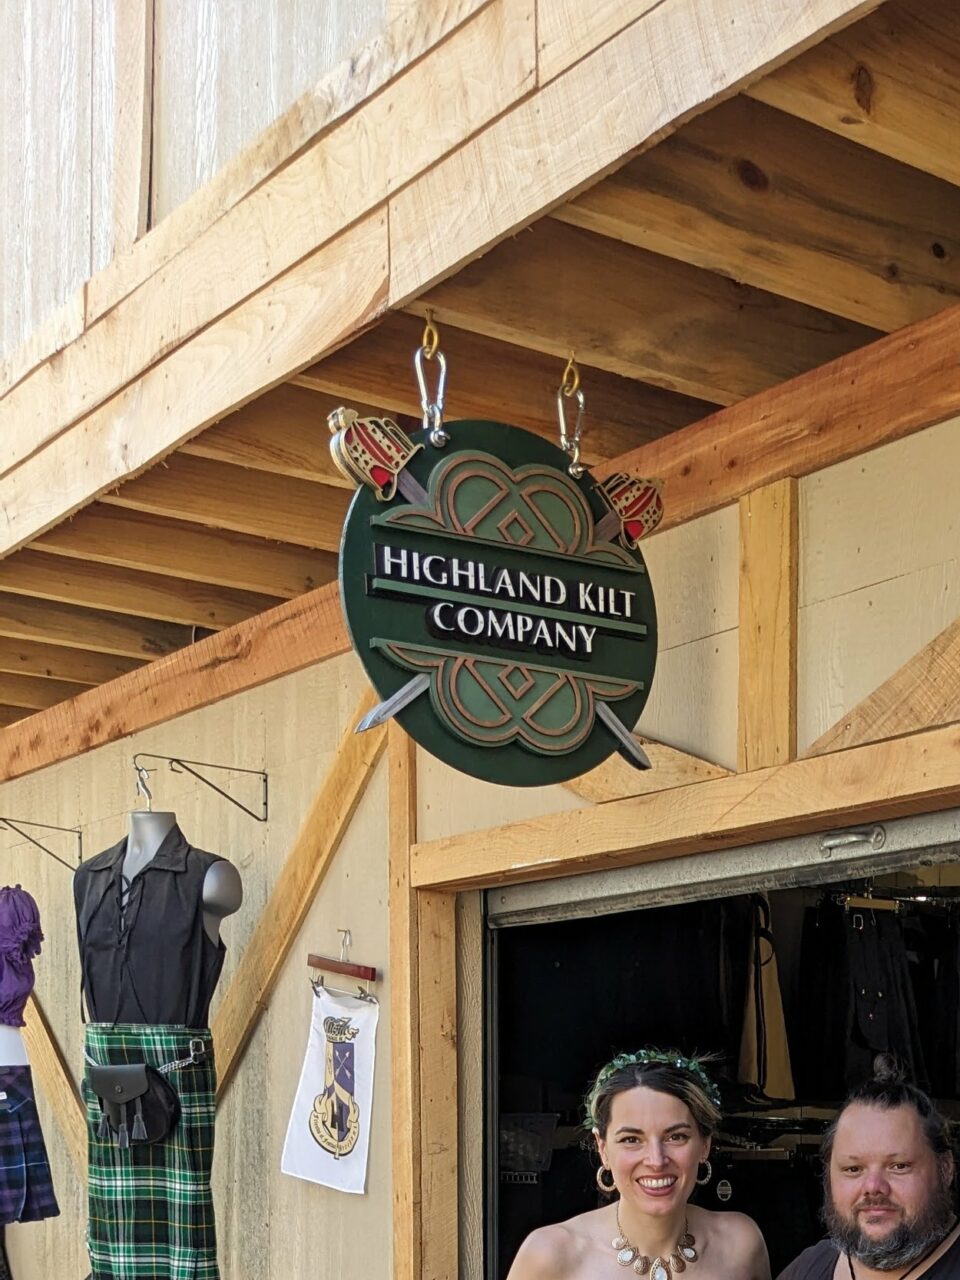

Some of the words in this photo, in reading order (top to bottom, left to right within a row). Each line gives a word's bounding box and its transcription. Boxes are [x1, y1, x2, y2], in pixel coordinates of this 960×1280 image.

[383, 546, 567, 606] HIGHLAND
[579, 582, 636, 618] KILT
[433, 602, 598, 653] COMPANY
